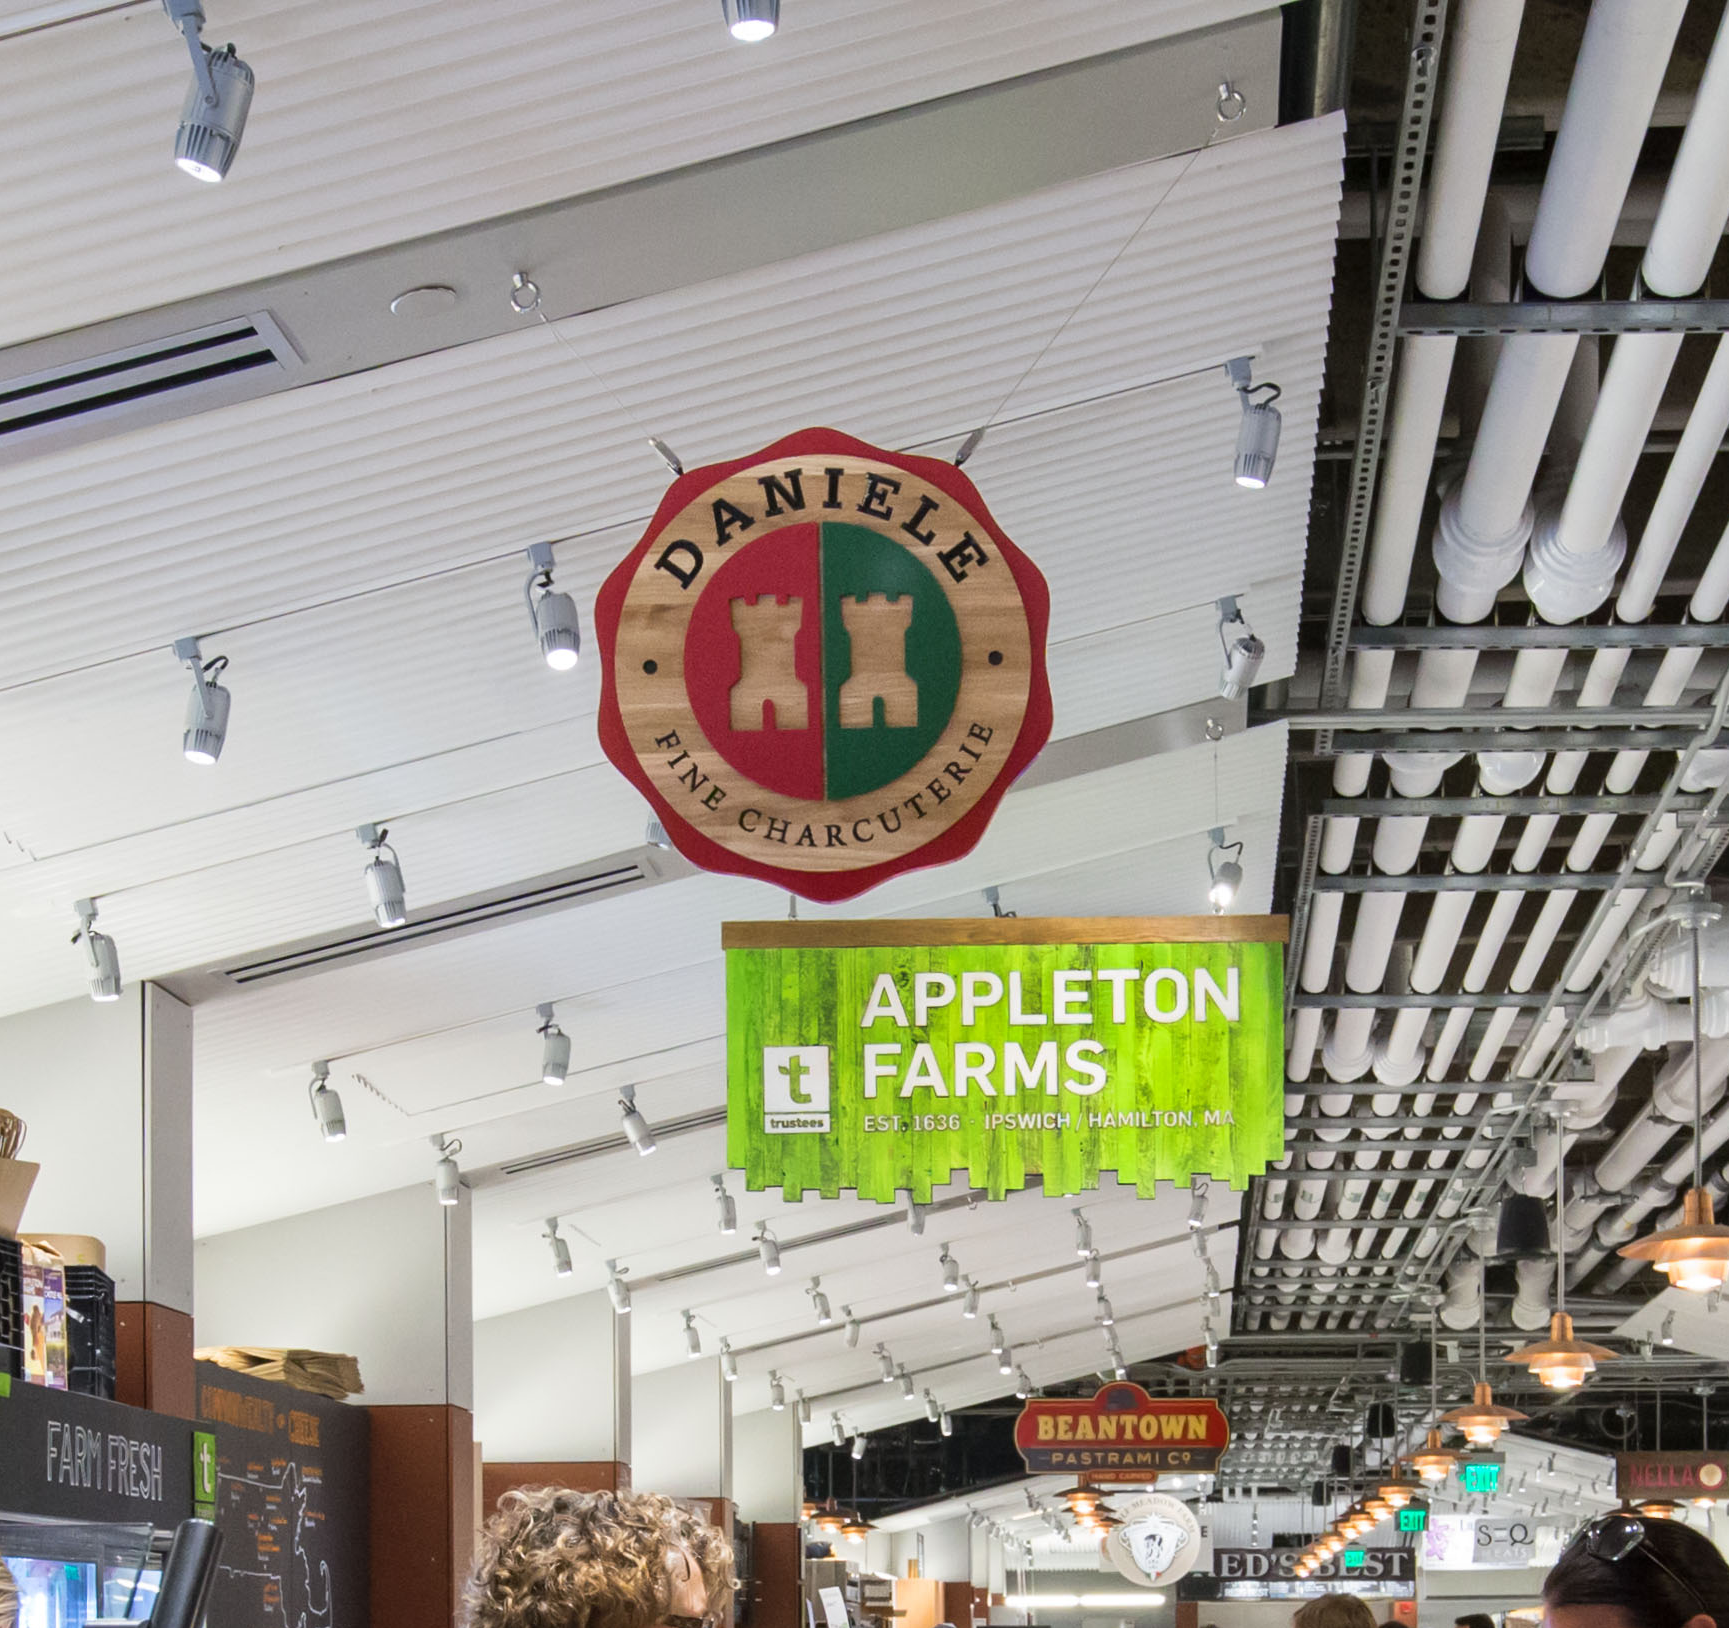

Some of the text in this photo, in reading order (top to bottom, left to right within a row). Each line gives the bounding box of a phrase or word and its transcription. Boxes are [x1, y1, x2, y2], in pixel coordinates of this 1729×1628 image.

[654, 468, 990, 590] DANIELE
[655, 722, 994, 847] FINE CHARCUTERIE
[861, 967, 1241, 1028] APPLETON
[863, 1039, 1108, 1099] FARMS
[770, 1118, 824, 1129] trustees
[913, 1114, 961, 1131] 1636
[984, 1112, 1071, 1131] IPSWICH
[1203, 1109, 1236, 1127] MA
[1036, 1414, 1208, 1441] BEANTOWN
[47, 1420, 163, 1501] FARM FRESH
[1051, 1452, 1160, 1465] PASTRAMI
[1466, 1465, 1499, 1492] EXIT
[1629, 1463, 1695, 1488] NELLA
[1400, 1510, 1426, 1532] EXIT
[1207, 1552, 1300, 1578] ED'S
